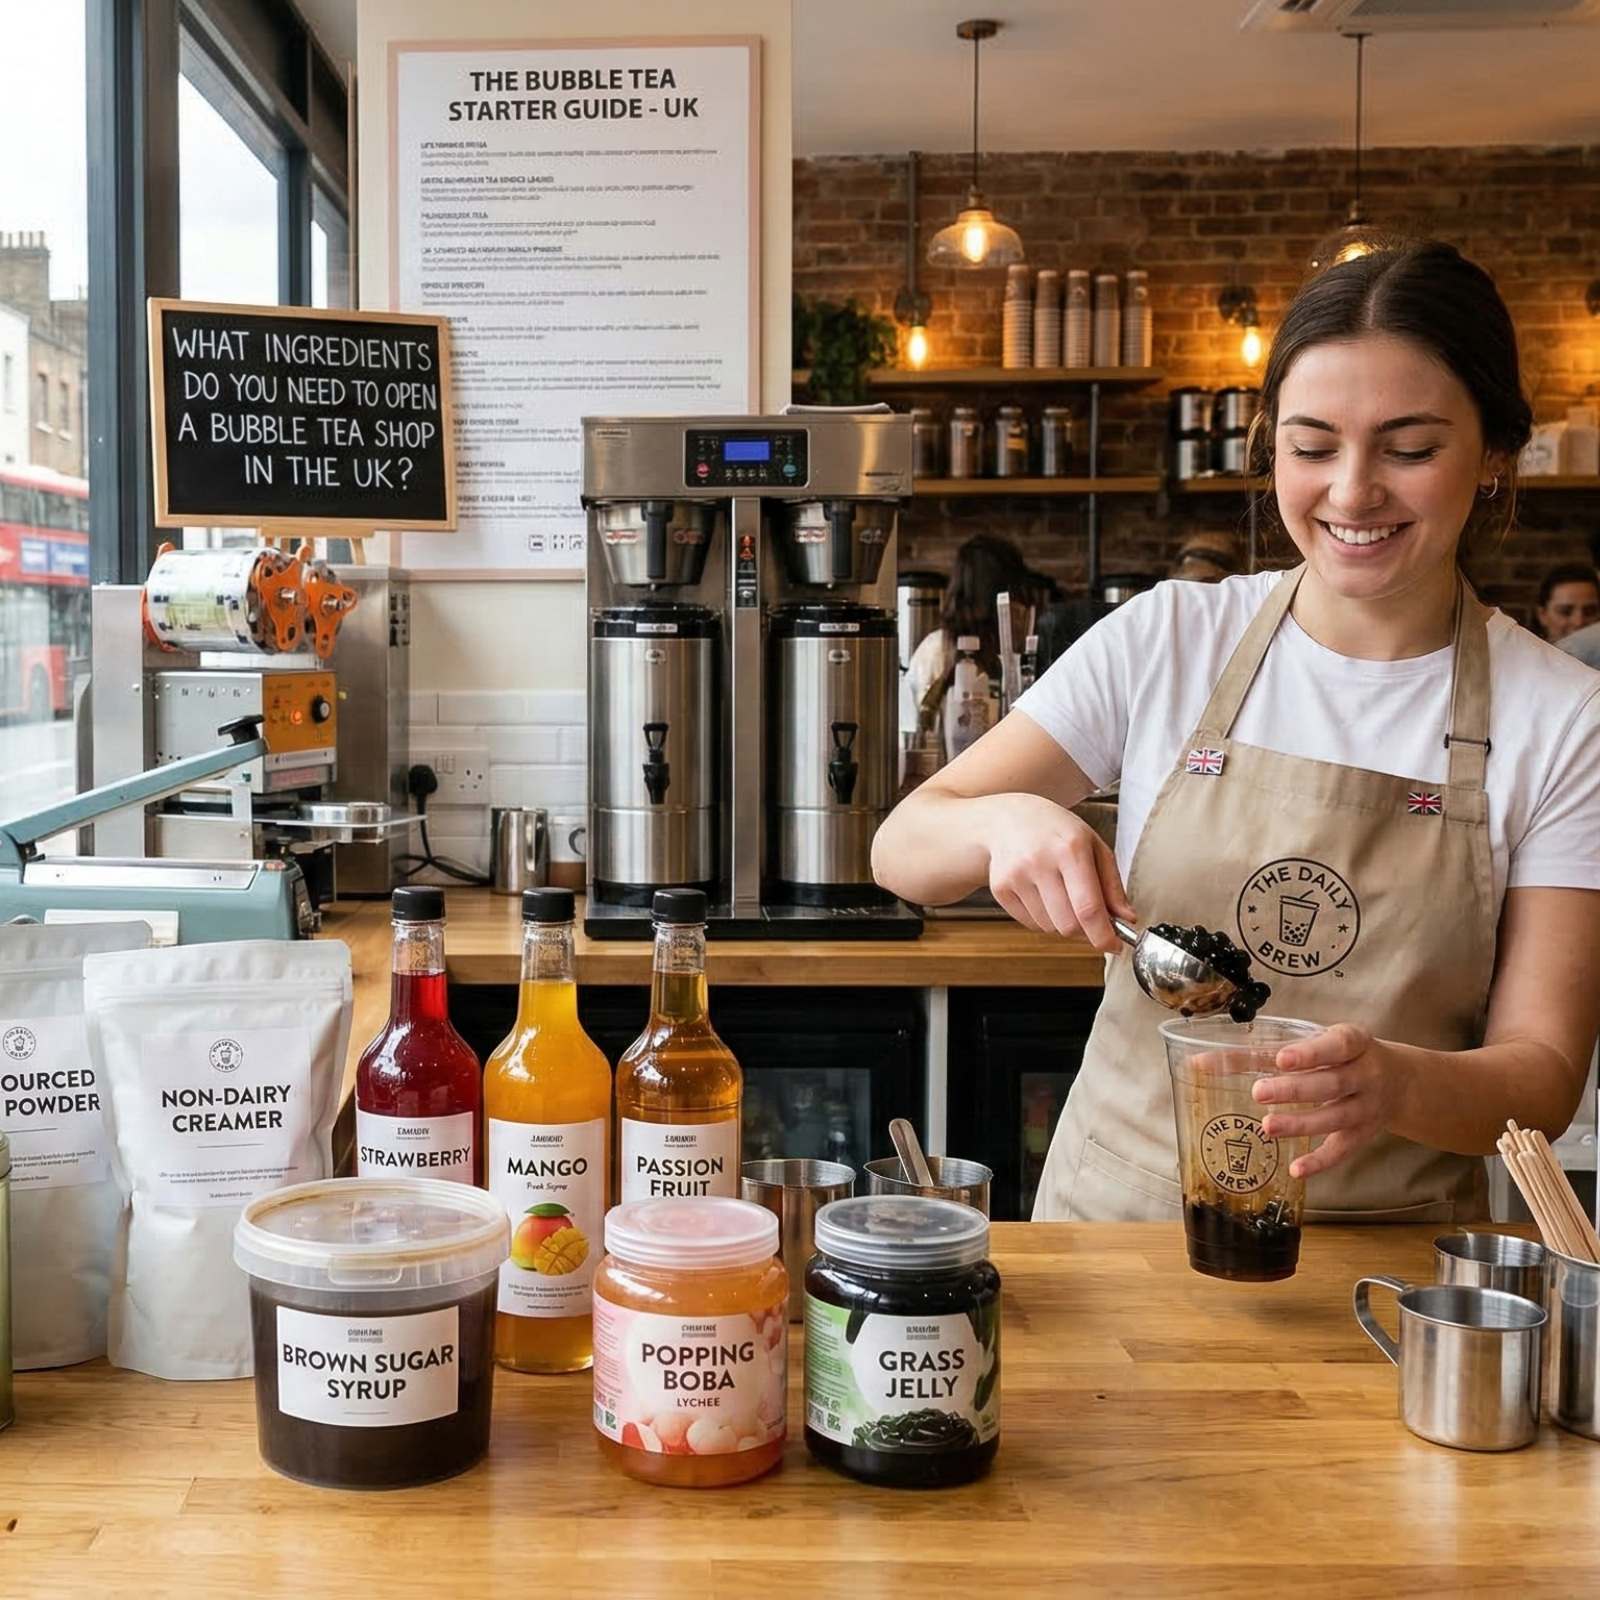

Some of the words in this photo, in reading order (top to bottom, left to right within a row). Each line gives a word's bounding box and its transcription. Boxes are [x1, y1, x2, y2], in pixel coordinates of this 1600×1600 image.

[470, 71, 518, 92] THE
[525, 69, 623, 91] BUBBLE
[628, 68, 677, 89] TEA
[448, 99, 557, 121] STARTER
[563, 98, 643, 120] GUIDE
[664, 97, 699, 118] UK
[172, 327, 249, 361] WHAT
[265, 333, 432, 371] INGREDIENTS
[184, 371, 219, 400] DO
[229, 373, 277, 402] YOU
[287, 377, 346, 405] NEED
[351, 380, 378, 406] TO
[385, 381, 437, 411] OPEN
[178, 412, 197, 442] A
[211, 413, 307, 445] BUBBLE
[317, 418, 364, 447] TEA
[374, 420, 435, 449] SHOP
[244, 454, 273, 484] IN
[285, 456, 340, 486] THE
[353, 456, 414, 490] UK?
[1251, 866, 1292, 894] THE
[1298, 866, 1352, 909] DAILY
[1257, 940, 1320, 969] BREW
[5, 1093, 101, 1117] POWDER
[162, 1084, 292, 1108] NON-DAIRY
[172, 1110, 283, 1133] CREAMER
[361, 1146, 470, 1168] STRAWBERRY
[507, 1157, 588, 1177] MANGO
[637, 1155, 723, 1176] PASSION
[651, 1179, 710, 1197] FRUIT
[1216, 1170, 1259, 1189] BREW
[283, 1343, 367, 1373] BROWN
[375, 1344, 454, 1373] SUGAR
[642, 1342, 754, 1366] POPPING
[878, 1349, 965, 1372] GRASS
[327, 1379, 407, 1400] SYRUP
[664, 1369, 735, 1391] BOBA
[885, 1375, 959, 1399] JELLY
[677, 1397, 721, 1407] LYCHEE
